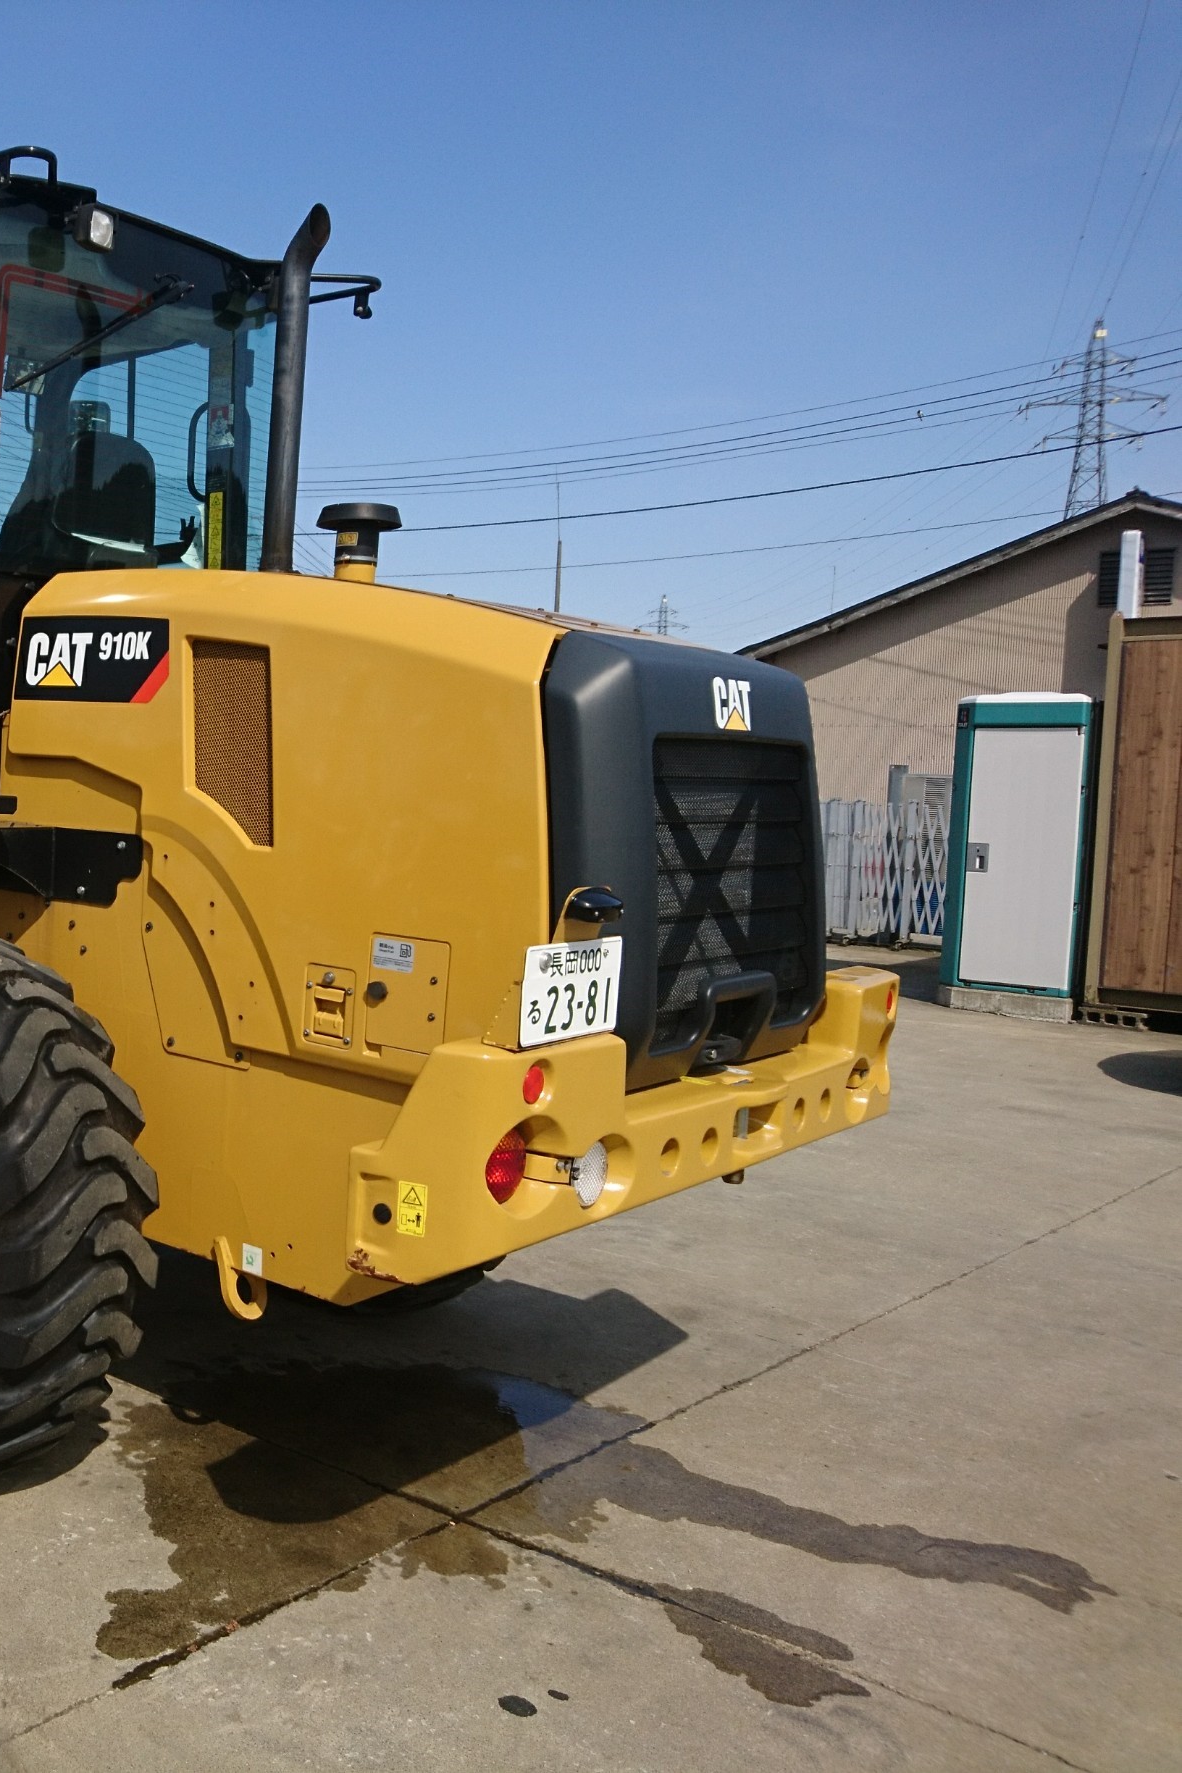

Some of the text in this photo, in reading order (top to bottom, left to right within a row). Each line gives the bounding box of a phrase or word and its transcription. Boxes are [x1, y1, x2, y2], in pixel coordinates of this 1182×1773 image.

[26, 631, 153, 687] CAT 910K
[712, 676, 751, 731] CAT
[527, 977, 611, 1034] る 23-81
